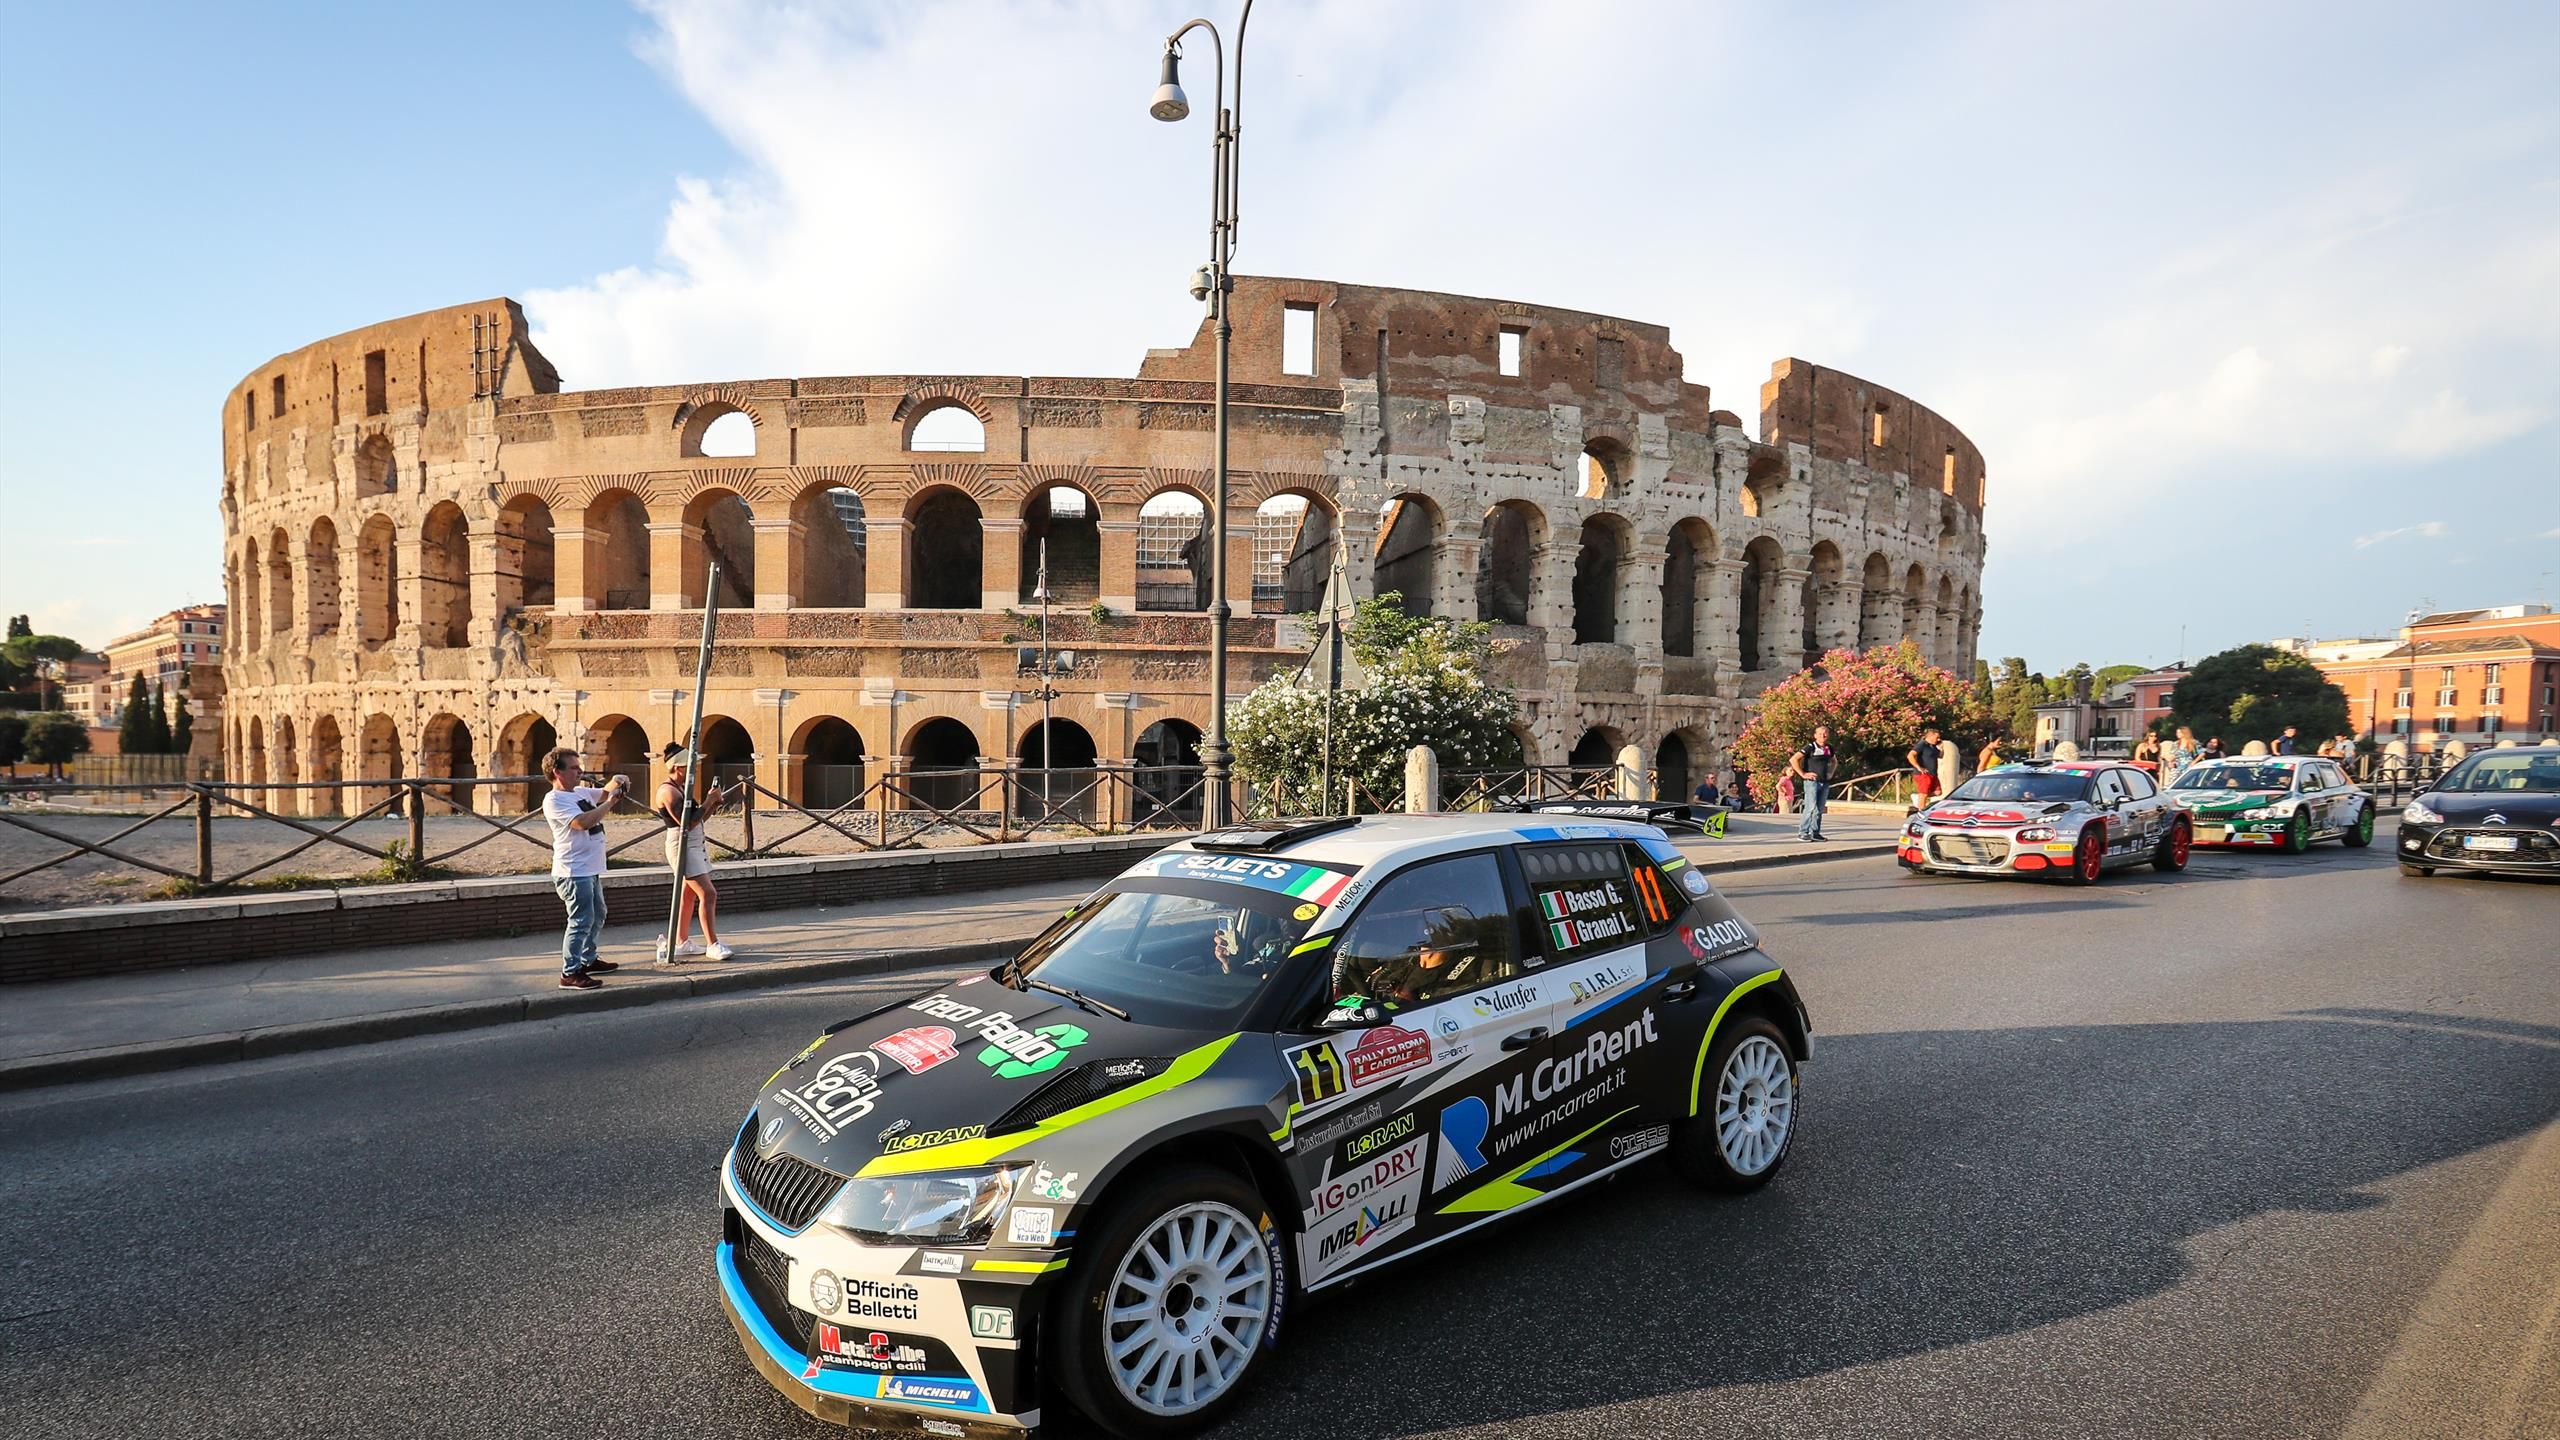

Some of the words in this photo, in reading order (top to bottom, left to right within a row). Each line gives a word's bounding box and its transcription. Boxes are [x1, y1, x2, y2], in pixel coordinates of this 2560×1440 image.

[1946, 809, 2008, 818] TOTAL
[1177, 854, 1292, 879] SEAJETS
[1335, 881, 1363, 913] METIOR
[1565, 887, 1603, 913] Basso
[1605, 881, 1622, 906] G.
[1634, 866, 1670, 923] 11
[1576, 916, 1622, 943] Granai
[1623, 911, 1635, 932] L.
[1694, 919, 1748, 950] GADDI
[1586, 967, 1621, 993] I.R.I.
[1493, 984, 1537, 1012] danfer
[908, 994, 984, 1023] Greco
[964, 1011, 1057, 1063] Paolo
[1441, 1020, 1459, 1034] ACI
[1353, 1048, 1385, 1066] RALLY
[1386, 1046, 1398, 1055] DI
[1398, 1037, 1426, 1052] ROMA
[1370, 1051, 1413, 1071] CAPITALE
[1437, 1045, 1469, 1061] SPORT
[841, 1066, 878, 1094] Main
[1105, 1064, 1134, 1074] METIOR
[1296, 1043, 1343, 1100] 11
[1494, 1007, 1659, 1126] M.CarRent
[788, 1102, 831, 1144] ENGINEERING
[1495, 1067, 1626, 1157] www.mcarrent.it
[884, 1125, 985, 1154] LORAN
[1347, 1113, 1415, 1161] LORAN
[1622, 1125, 1670, 1148] TECO
[1032, 1163, 1079, 1200] S&C
[1313, 1144, 1418, 1216] IGonDRY
[1319, 1195, 1408, 1262] IMBALLI
[845, 1279, 919, 1301] Officine
[1268, 1246, 1284, 1340] MICHELIN
[847, 1299, 918, 1320] Belletti
[978, 1312, 1012, 1333] DF
[822, 1354, 892, 1370] stampaggi
[896, 1361, 926, 1371] edili
[905, 1384, 972, 1400] MICHELIN
